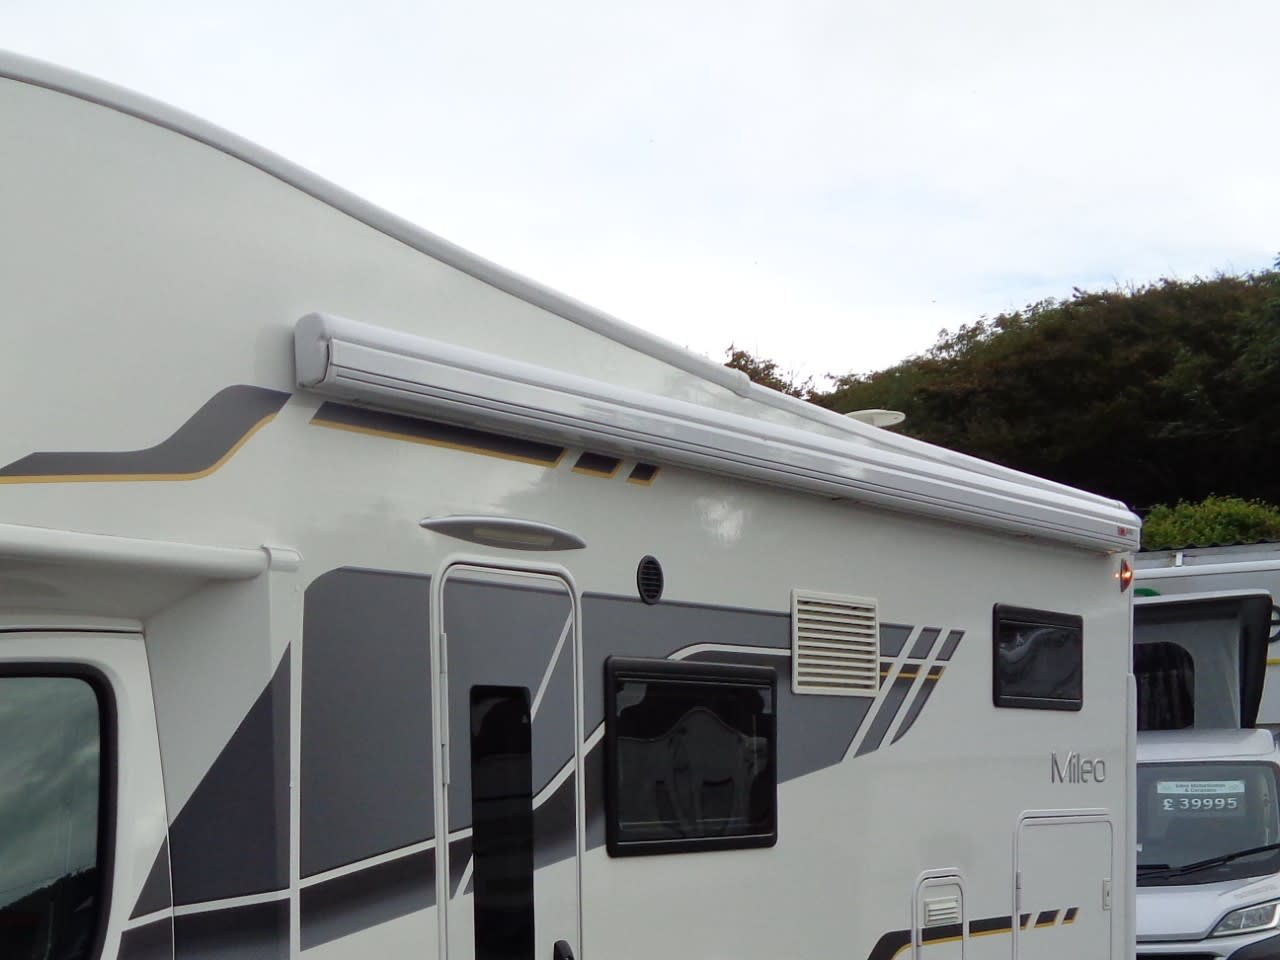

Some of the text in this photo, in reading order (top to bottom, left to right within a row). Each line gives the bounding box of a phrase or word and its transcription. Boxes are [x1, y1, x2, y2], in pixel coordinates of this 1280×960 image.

[1051, 751, 1106, 784] Mileo
[1163, 797, 1238, 811] £ 39995
